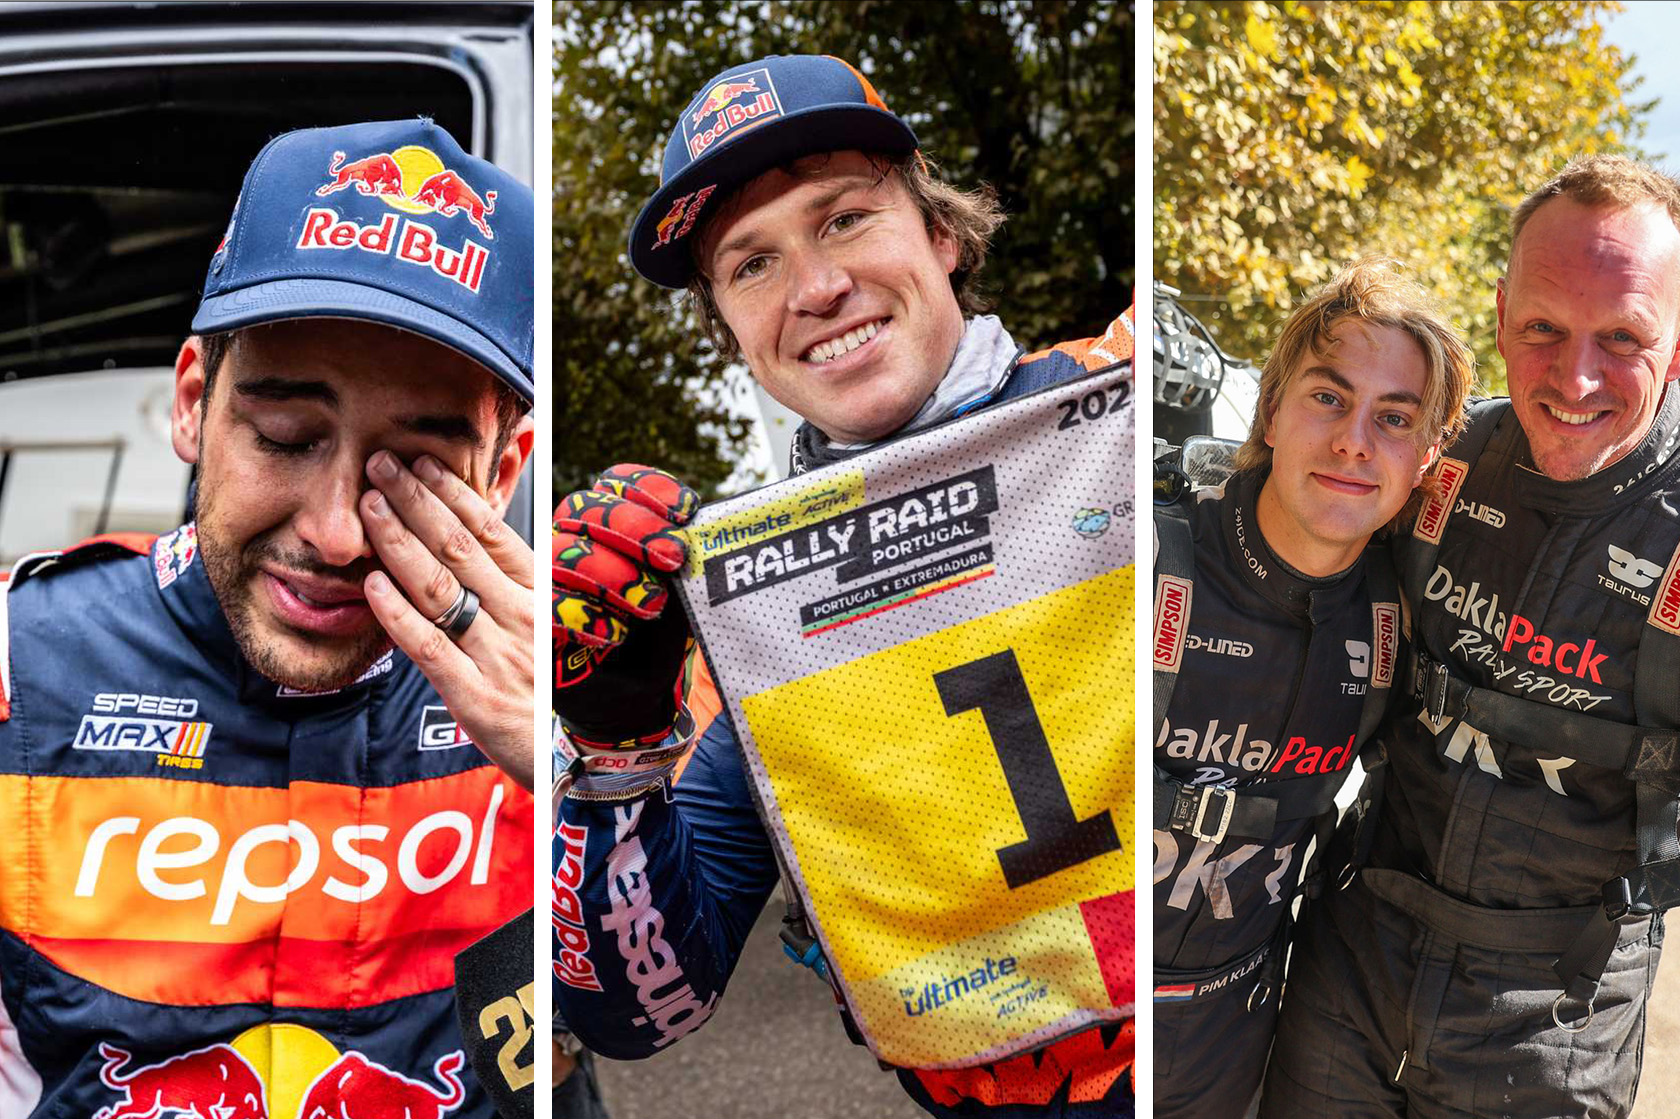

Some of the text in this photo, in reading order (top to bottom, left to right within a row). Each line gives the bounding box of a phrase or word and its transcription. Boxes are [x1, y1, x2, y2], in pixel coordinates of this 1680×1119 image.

[690, 92, 776, 159] Red Bull
[296, 208, 490, 294] Red Bull
[724, 481, 979, 592] RALLY RAID
[872, 520, 975, 565] PORTUGAL
[813, 551, 988, 617] PORTUGAL EXTREMADURA
[1155, 588, 1183, 661] SIMPSON
[1380, 613, 1393, 679] SIMPSON
[1424, 565, 1609, 685] DaklaPack
[93, 693, 199, 718] SPEED
[1514, 670, 1612, 712] SPORT
[157, 753, 204, 769] TIRES
[933, 648, 1121, 890] 1
[74, 784, 505, 925] repsol
[904, 956, 1017, 1017] ultimate
[1198, 976, 1228, 996] PIM
[479, 980, 534, 1091] 2
